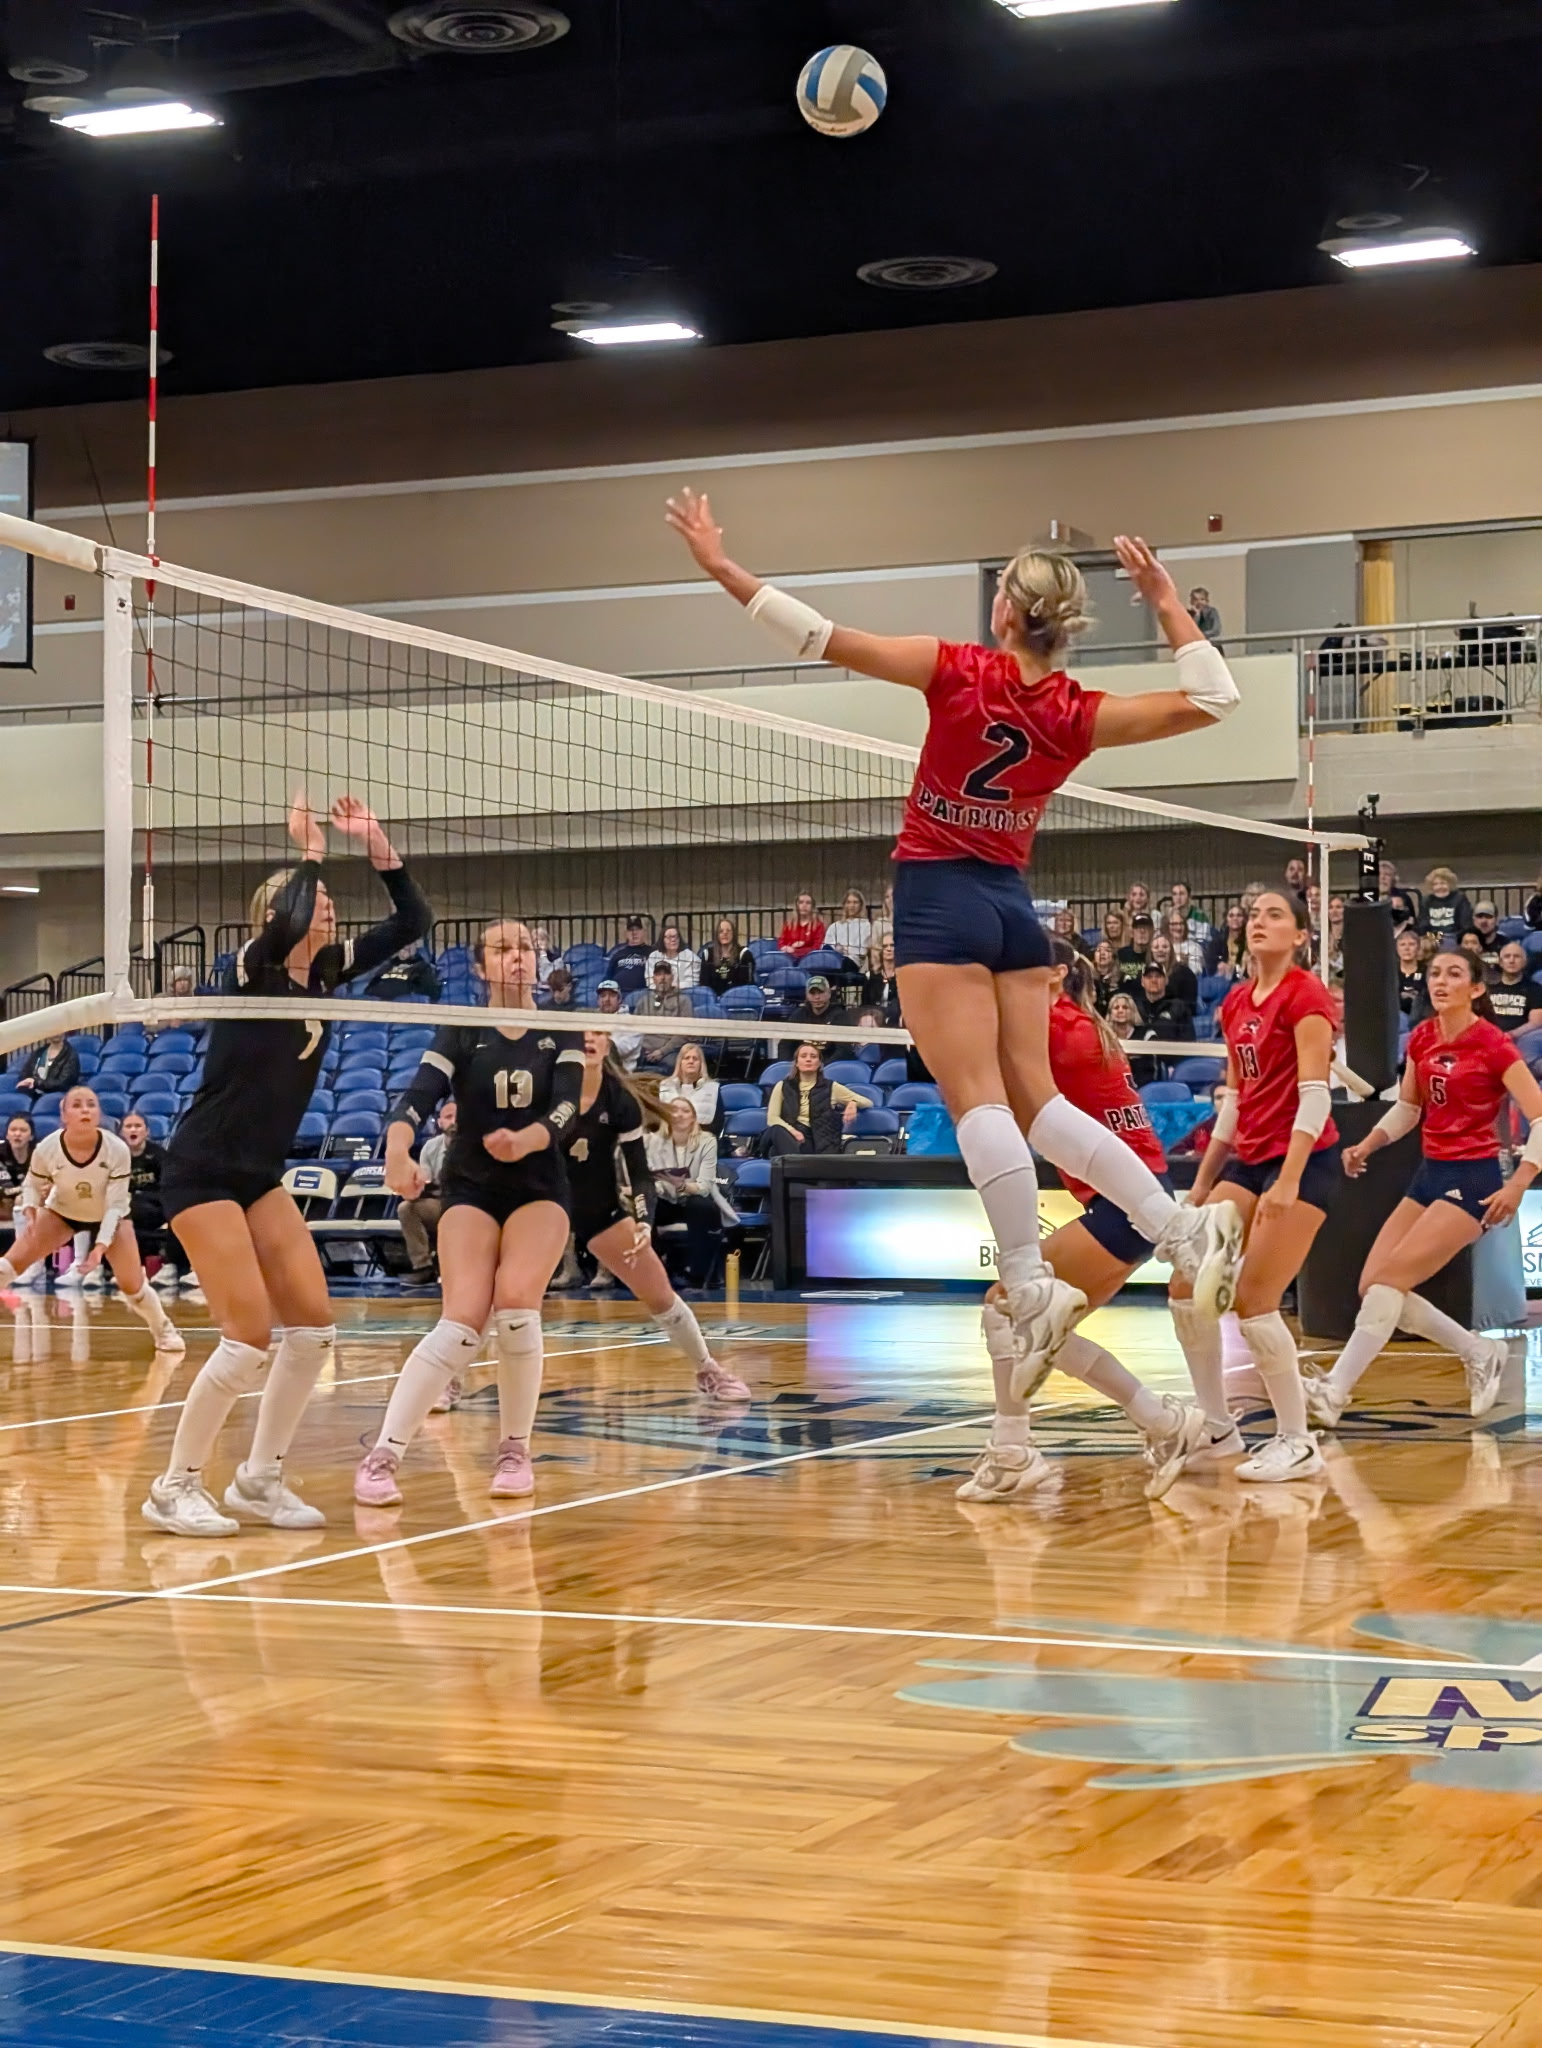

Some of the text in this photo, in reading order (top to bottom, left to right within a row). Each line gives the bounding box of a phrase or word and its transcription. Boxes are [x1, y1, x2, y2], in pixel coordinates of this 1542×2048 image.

[958, 721, 1033, 804] 2
[1235, 1044, 1260, 1081] 13
[493, 1069, 533, 1109] 13
[1429, 1074, 1448, 1107] 5
[568, 1137, 590, 1163] 4
